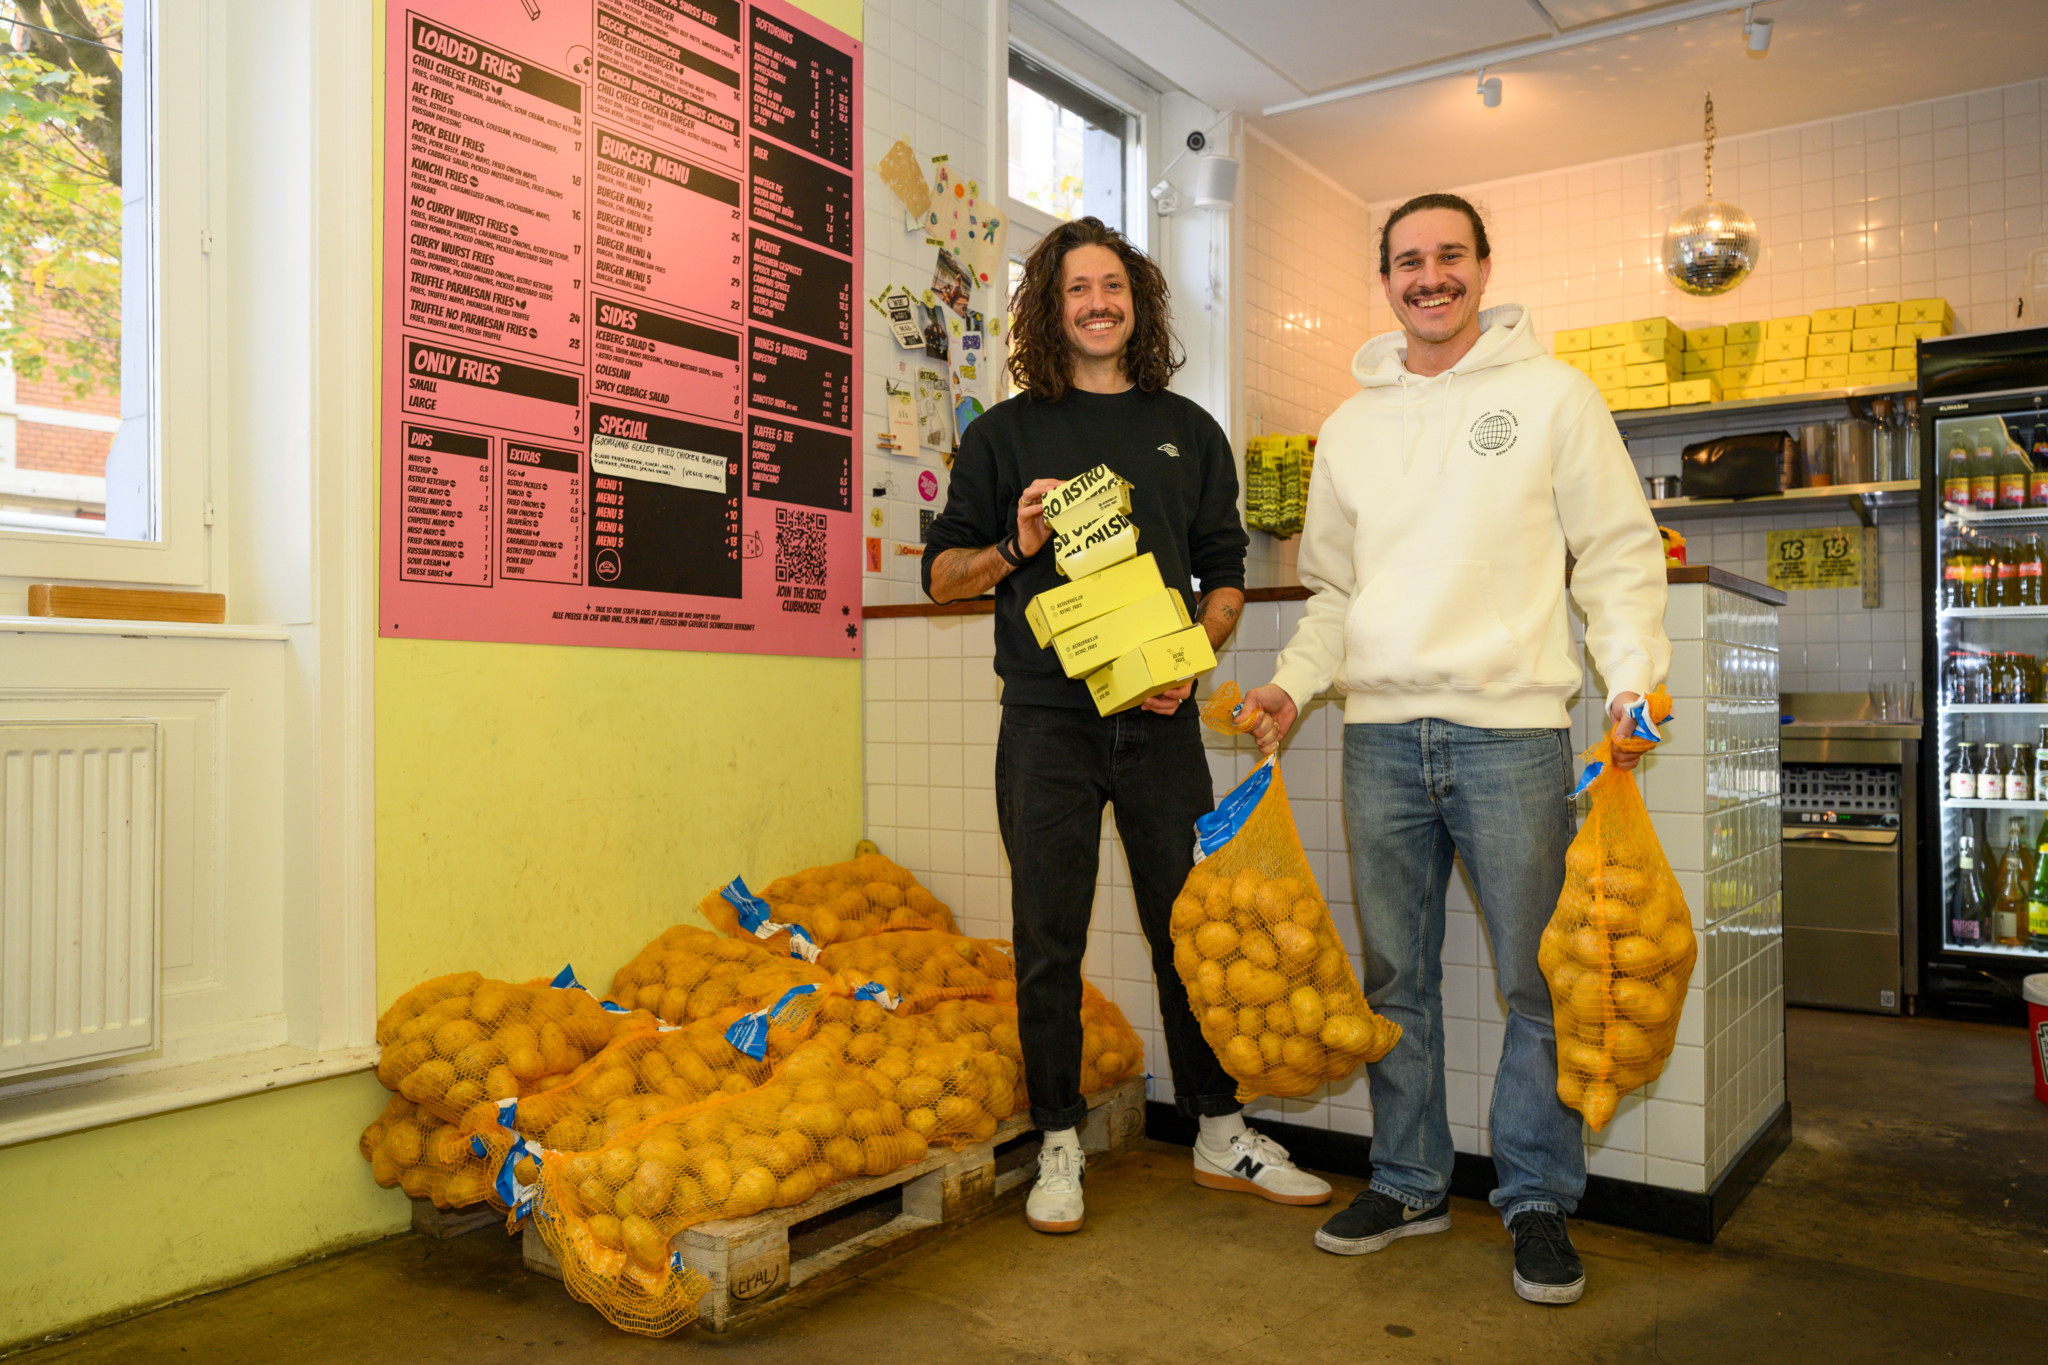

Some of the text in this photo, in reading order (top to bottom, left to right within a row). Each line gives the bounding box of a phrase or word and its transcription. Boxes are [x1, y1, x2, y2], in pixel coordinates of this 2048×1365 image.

[600, 15, 680, 61] VEGGIE SMASHBURGER
[755, 17, 793, 45] SOFTDRINKS
[417, 26, 522, 85] LOADED FRIES
[598, 31, 674, 72] DOUBLE CHEESEBURGER
[734, 44, 740, 54] 16
[413, 54, 490, 92] CHILI CHEESE FRIES
[412, 82, 454, 105] AFC FRIES
[600, 67, 734, 132] CHICKEN BURGER 100% SWISS CHICKEN
[734, 92, 740, 101] 16
[598, 83, 695, 130] CHILI CHEESE CHICKEN BURGER
[412, 106, 462, 129] RUSSIAN DRESSING
[573, 117, 581, 126] 14
[412, 120, 485, 153] PORK BELLY FRIES
[733, 139, 740, 149] 16
[575, 142, 582, 152] 17
[754, 146, 768, 161] BIER
[600, 135, 690, 185] BURGER MENU
[411, 157, 468, 184] KIMCHI FRIES
[598, 161, 625, 179] BURGER
[626, 172, 646, 186] MENU
[572, 176, 581, 186] 18
[597, 186, 652, 212] BURGER MENU 2
[411, 196, 509, 233] NO CURRY WURST FRIES
[572, 210, 581, 221] 16
[732, 210, 740, 220] 22
[732, 233, 740, 242] 26
[411, 234, 494, 266] CURRY WURST FRIES
[574, 245, 581, 255] 17
[755, 238, 781, 256] APERITIF
[597, 261, 652, 285] BURGER MENU 5
[411, 272, 515, 307] TRUFFLE PARMESAN FRIES
[573, 280, 581, 289] 17
[731, 300, 740, 310] 22
[410, 300, 528, 337] TRUFFLE NO PARMESAN FRIES
[569, 313, 580, 324] 24
[600, 304, 638, 331] SIDES
[569, 339, 580, 349] 23
[596, 330, 647, 351] ICEBERG SALAD
[755, 337, 808, 361] WINES & BUBBLES
[414, 349, 501, 385] ONLY FRIES
[596, 364, 631, 381] COLESLAW
[735, 365, 739, 373] 9
[409, 378, 437, 393] SMALL
[595, 380, 669, 404] SPICY CABBAGE SALAD
[409, 396, 437, 410] LARGE
[734, 396, 739, 405] 8
[575, 411, 580, 420] 7
[734, 410, 739, 419] 8
[574, 427, 579, 436] 9
[599, 415, 648, 441] SPECIAL
[754, 425, 794, 443] KAFFEE & TEE
[411, 433, 433, 447] DIPS
[752, 441, 776, 452] ESPRESSO
[510, 449, 541, 464] EXTRAS
[408, 465, 431, 474] KETCHUP
[729, 464, 737, 475] 18
[408, 486, 443, 496] GARLIC MAYO
[596, 478, 622, 492] MENU 1
[1062, 464, 1105, 507] ASTRO
[596, 493, 624, 506] MENU 2
[1781, 537, 1848, 560] 16 18
[407, 568, 426, 576] CHEESE
[776, 585, 826, 600] JOIN THE ASTRO
[782, 600, 822, 614] CLUBHOUSE!
[564, 612, 582, 620] PREISE
[1234, 1154, 1265, 1179] N
